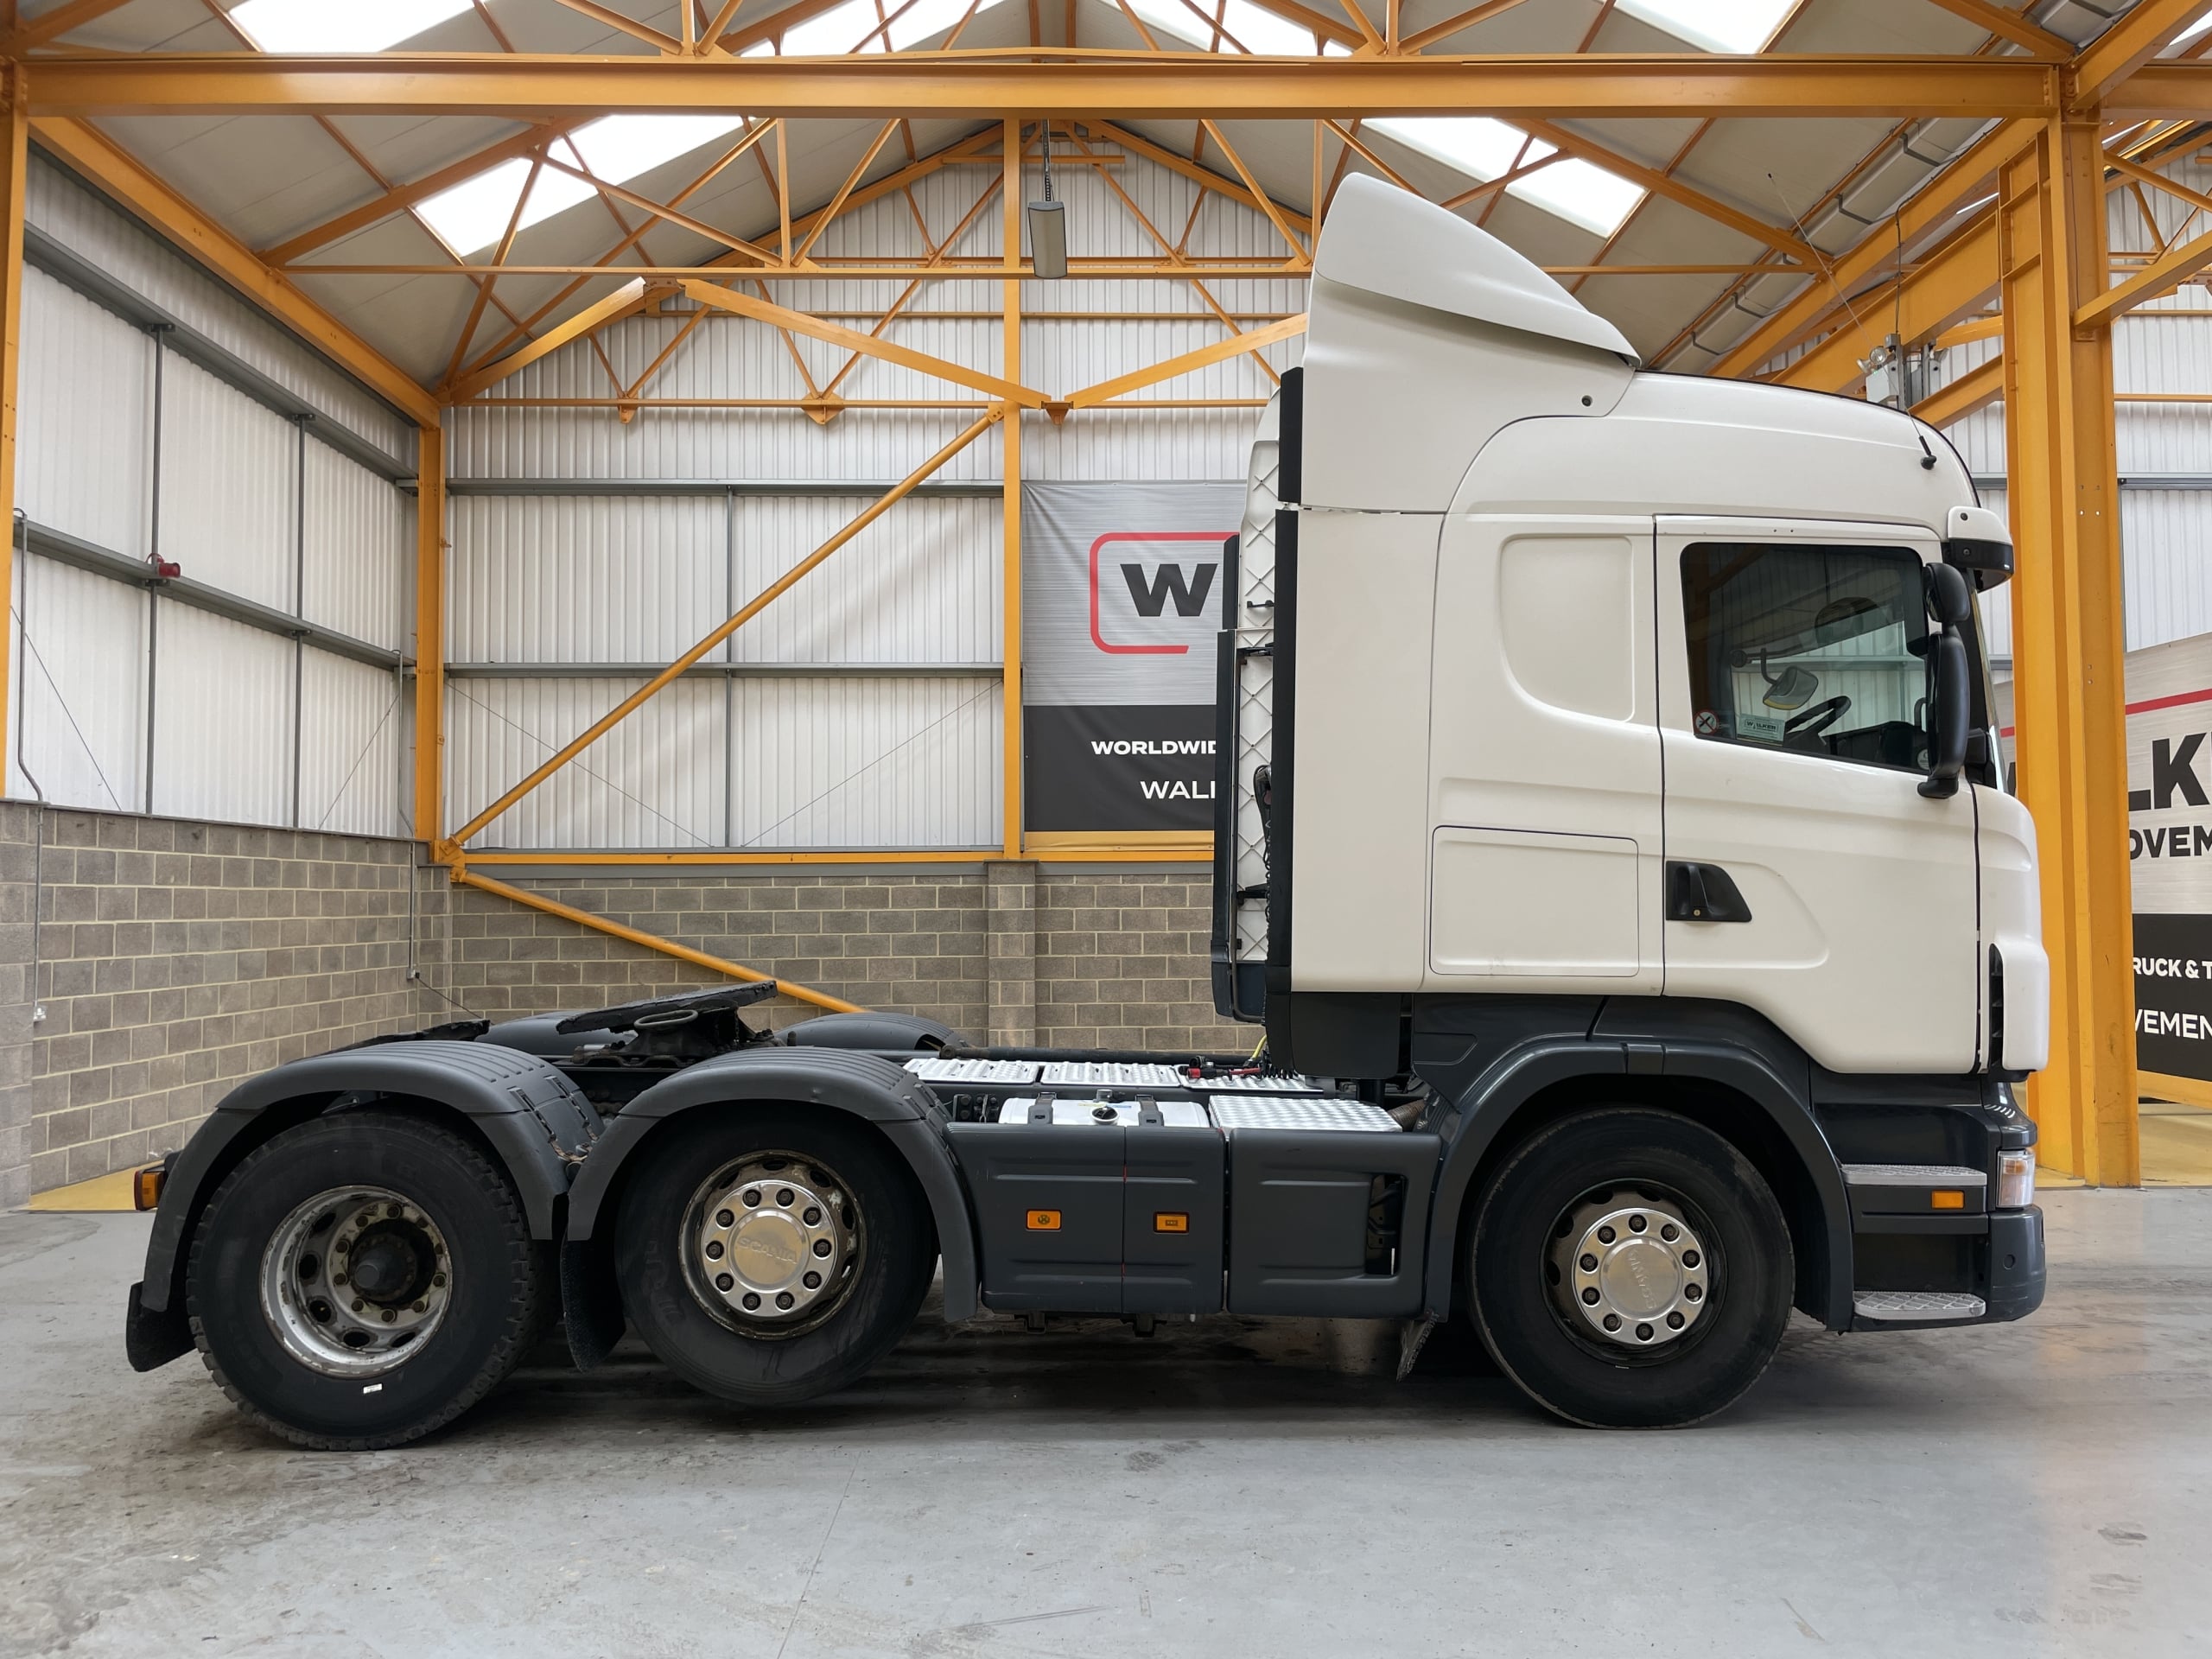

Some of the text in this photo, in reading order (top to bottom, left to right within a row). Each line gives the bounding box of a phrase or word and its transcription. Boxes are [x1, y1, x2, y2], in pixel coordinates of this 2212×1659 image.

[1120, 563, 1218, 617] W
[1140, 780, 1216, 799] WAL
[2133, 957, 2183, 977] RUCK
[2184, 959, 2201, 979] &
